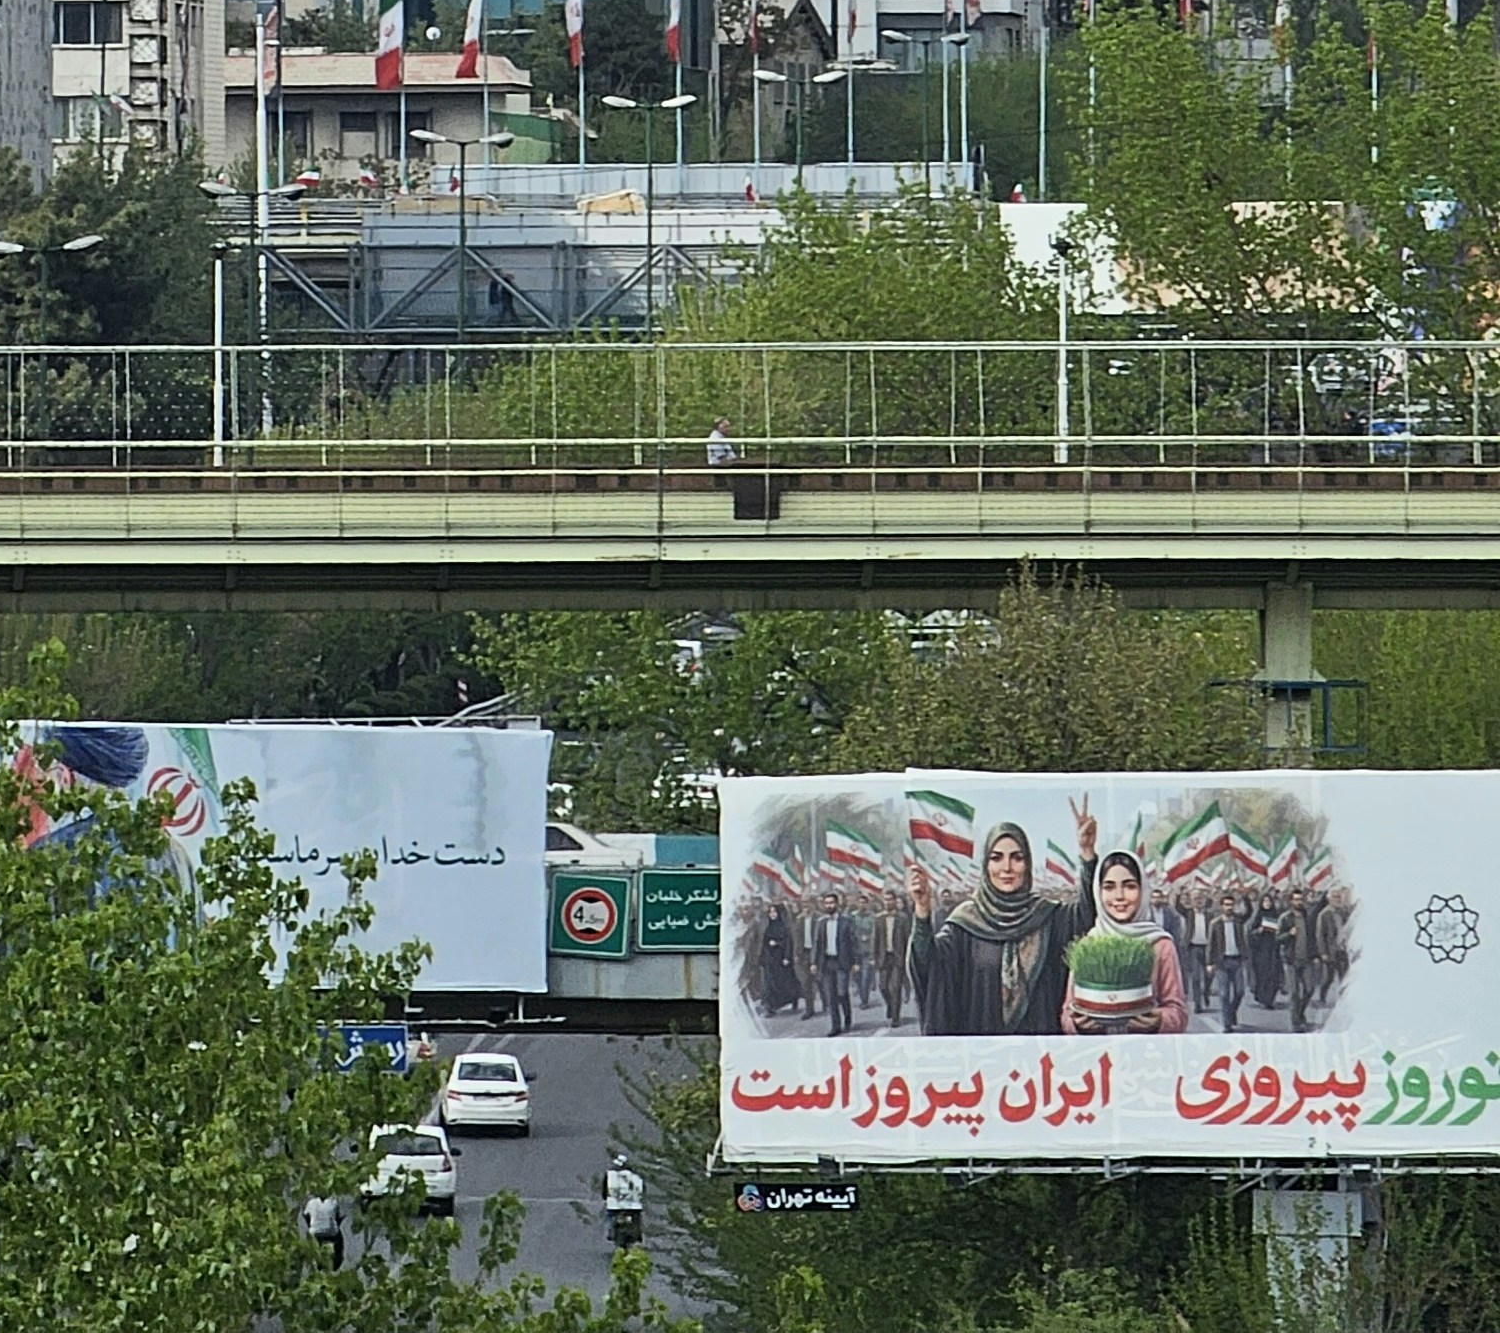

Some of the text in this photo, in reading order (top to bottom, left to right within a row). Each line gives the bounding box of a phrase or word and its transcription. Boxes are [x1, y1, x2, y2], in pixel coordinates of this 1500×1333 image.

[381, 834, 430, 866] خدا
[434, 841, 506, 866] دست
[646, 888, 721, 907] لشکر خلبان
[730, 1052, 853, 1113] است
[851, 1065, 985, 1137] پیروز
[998, 1051, 1113, 1127] ایران
[1175, 1049, 1367, 1133] پیروزی
[1360, 1049, 1500, 1126] نوروز
[765, 1187, 814, 1209] تهران
